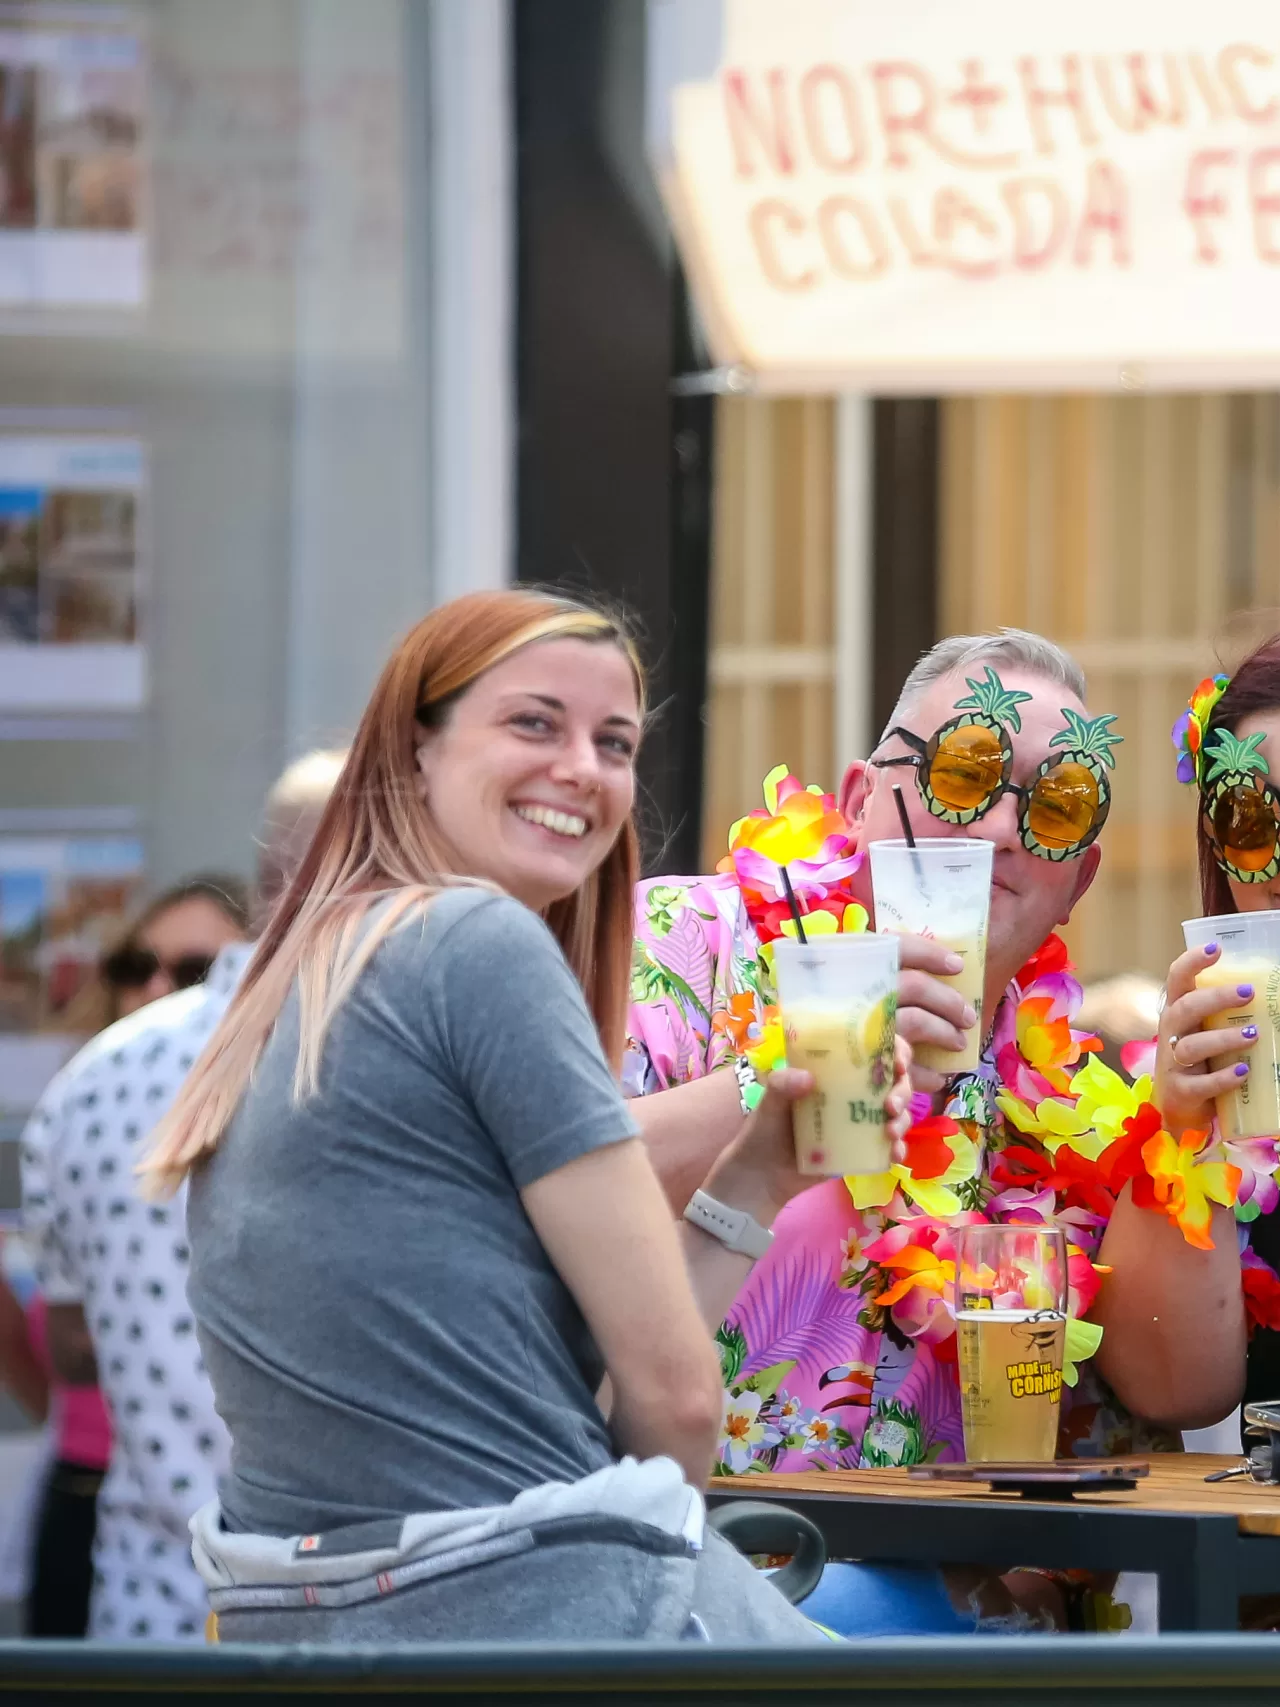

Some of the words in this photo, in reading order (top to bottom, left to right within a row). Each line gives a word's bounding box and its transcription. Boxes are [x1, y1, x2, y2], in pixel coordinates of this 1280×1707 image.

[746, 158, 1131, 296] COLADA
[1006, 1361, 1039, 1379] MADE
[1039, 1362, 1052, 1374] THE
